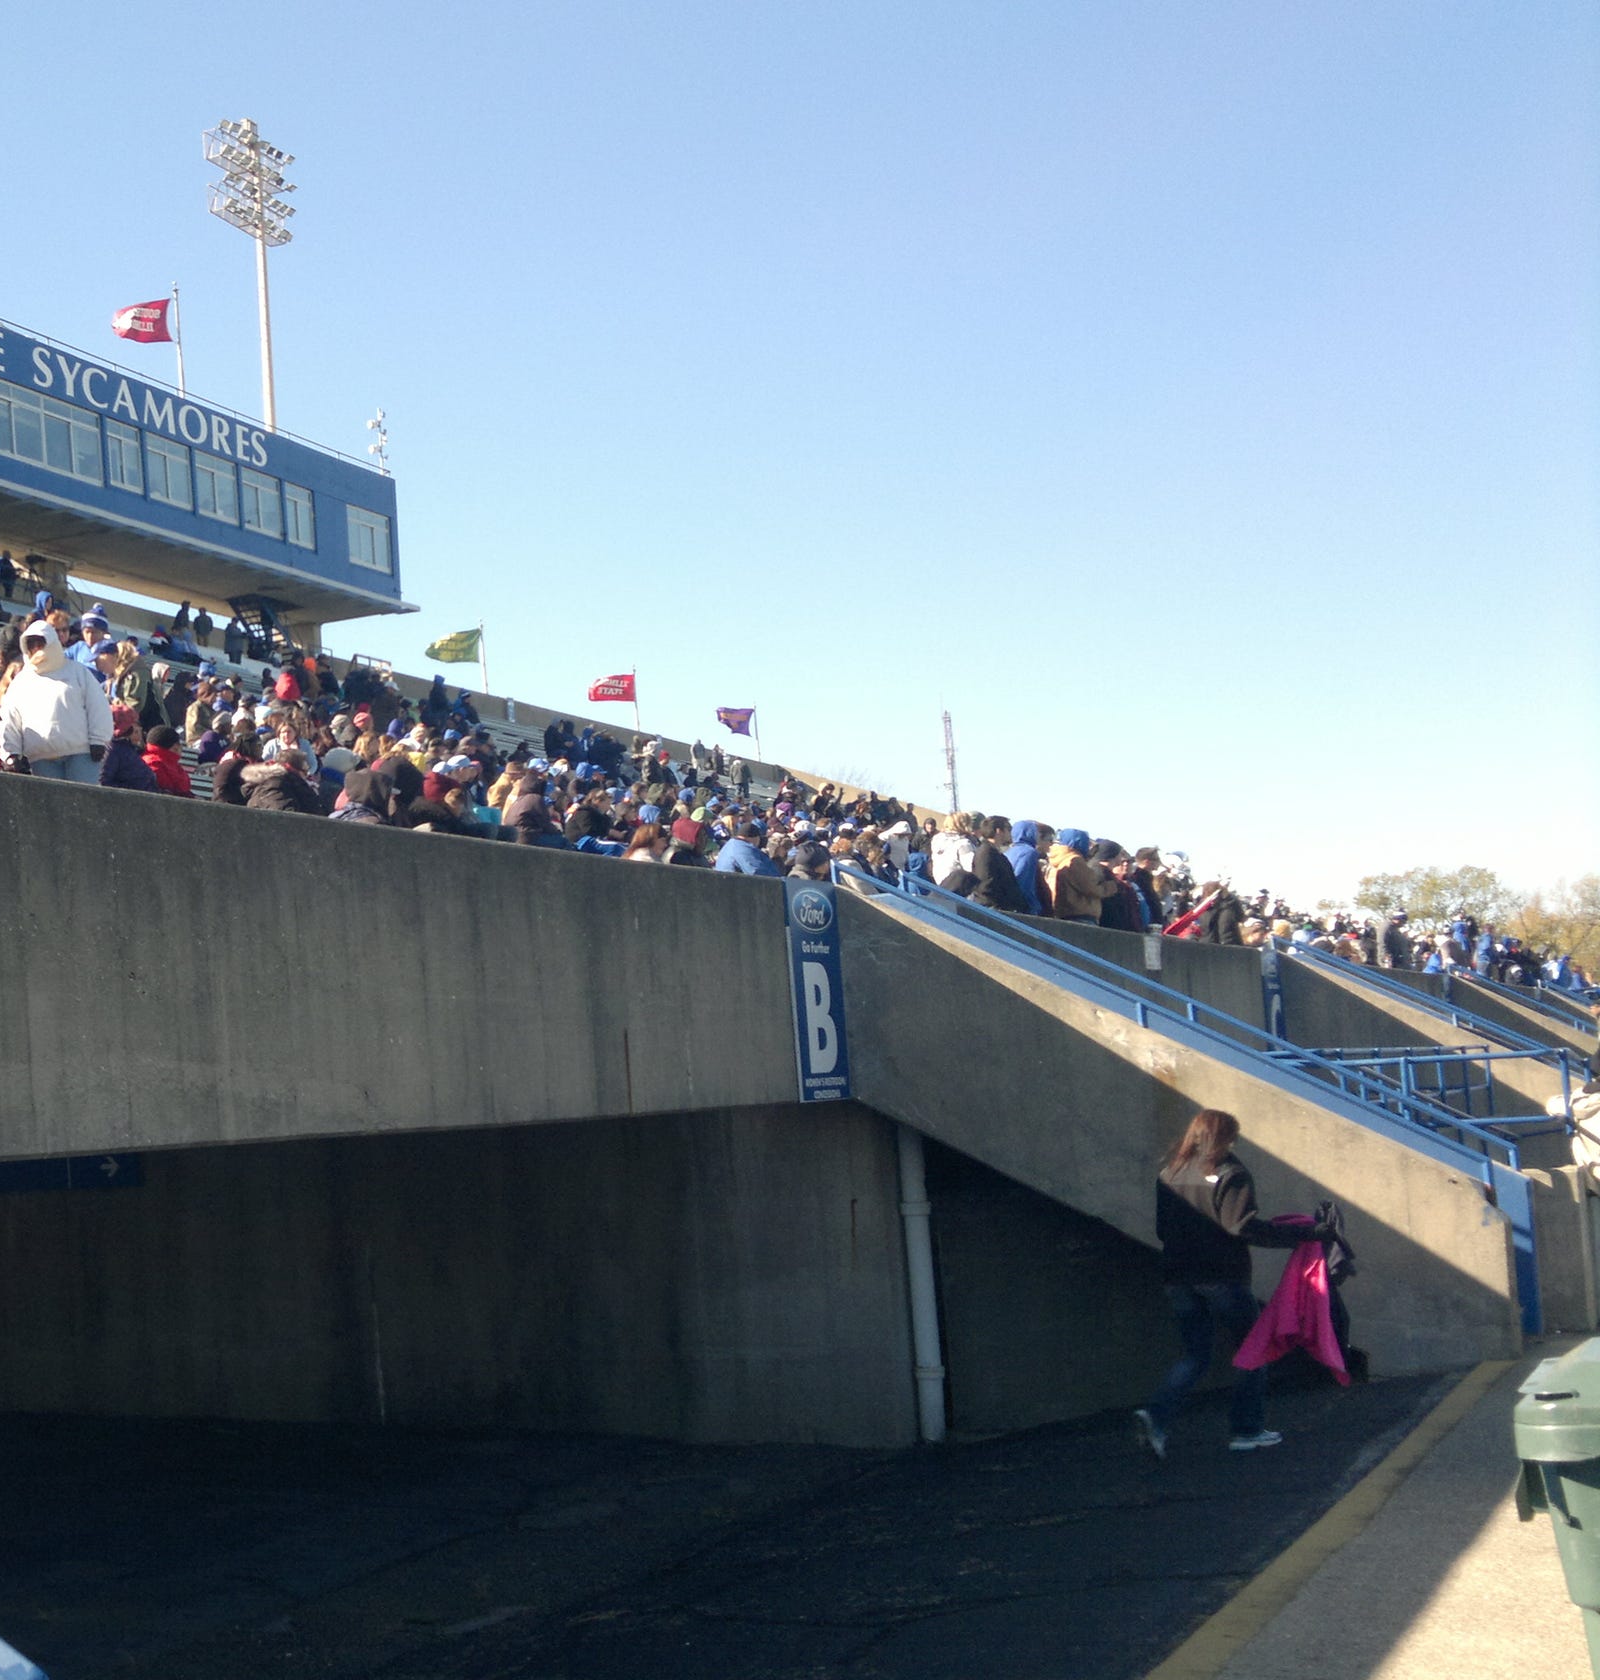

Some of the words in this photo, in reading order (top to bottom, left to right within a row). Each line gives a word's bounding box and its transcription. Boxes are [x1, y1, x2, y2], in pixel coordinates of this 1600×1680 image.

[32, 347, 267, 467] SYCAMORES
[800, 894, 826, 925] Ford
[802, 961, 839, 1075] B
